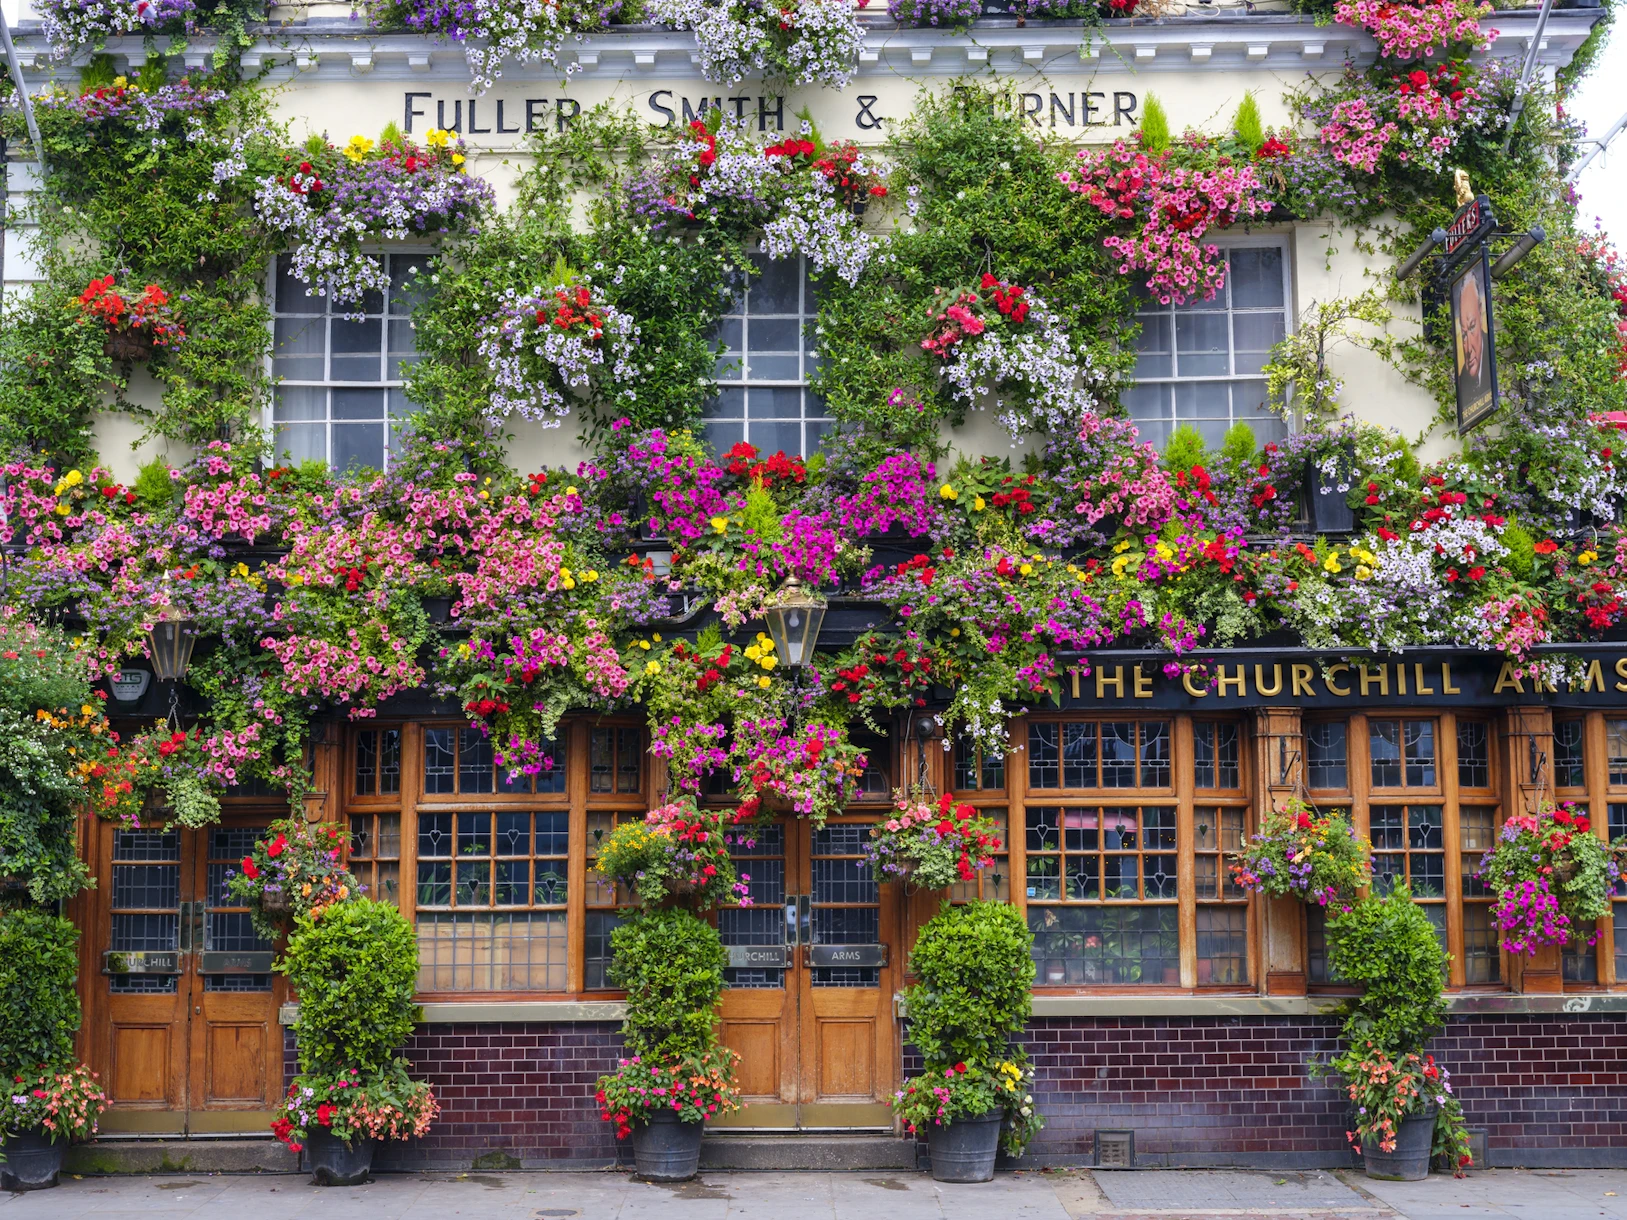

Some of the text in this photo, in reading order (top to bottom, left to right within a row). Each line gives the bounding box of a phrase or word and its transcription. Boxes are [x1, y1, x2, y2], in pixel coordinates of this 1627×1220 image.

[404, 92, 580, 134] FULLER
[855, 95, 883, 130] &
[954, 86, 1137, 128] URNER
[1066, 664, 1153, 699] THE
[1182, 663, 1461, 697] CHURCHILL
[831, 951, 861, 961] ARMS
